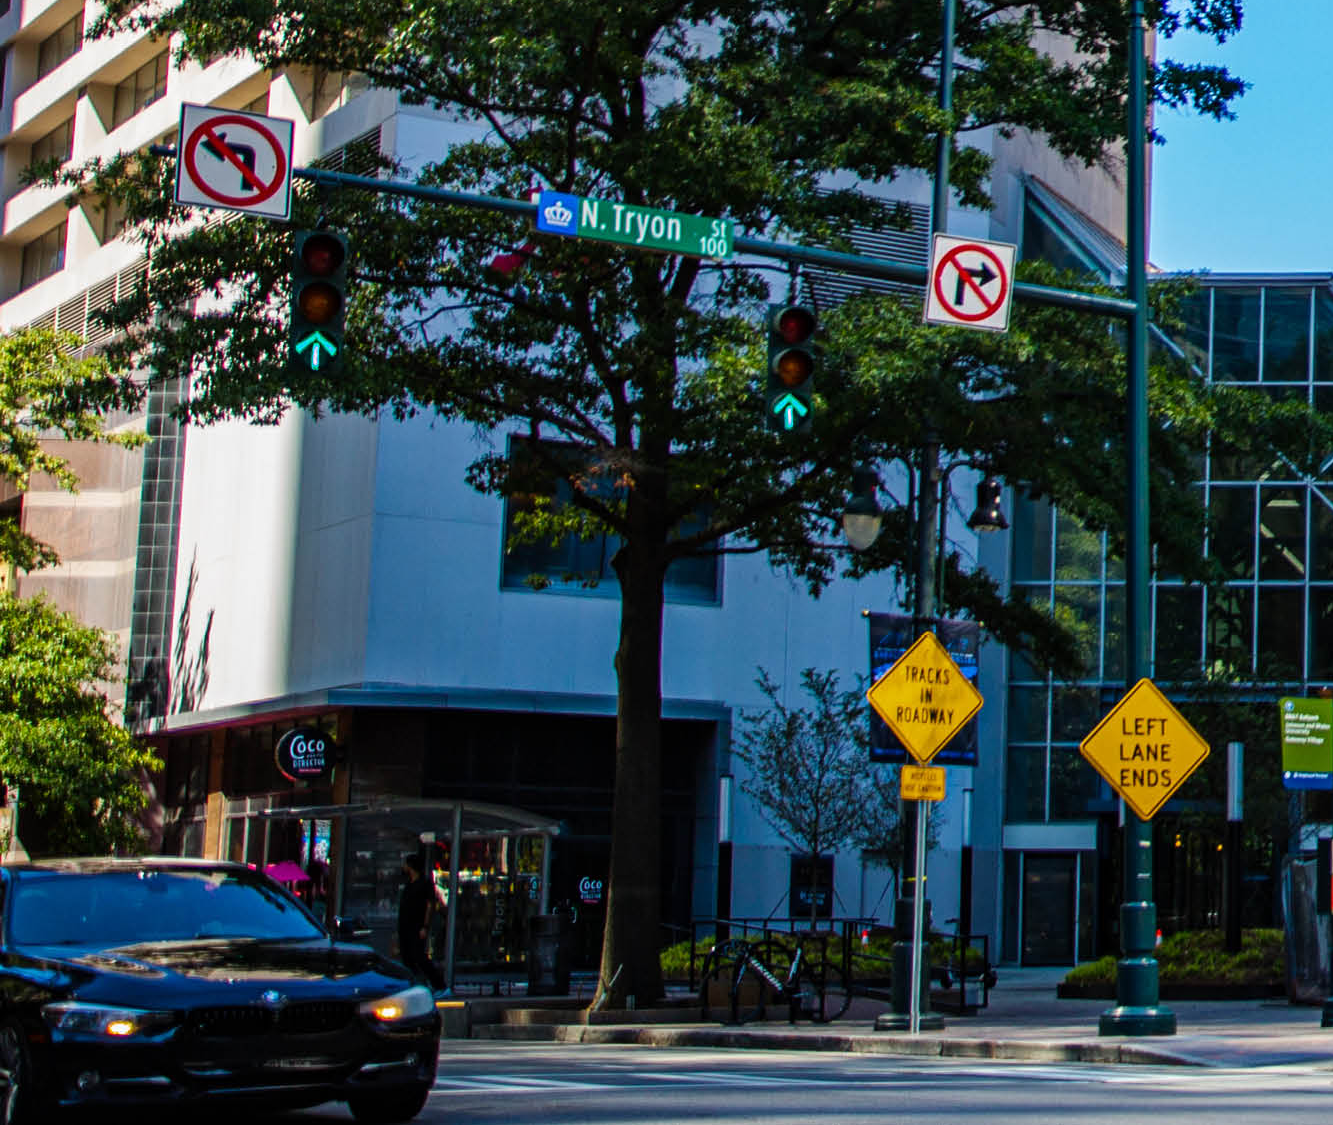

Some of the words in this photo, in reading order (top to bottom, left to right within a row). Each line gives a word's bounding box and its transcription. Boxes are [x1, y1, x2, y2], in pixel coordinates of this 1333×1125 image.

[581, 200, 606, 230] N.
[612, 204, 681, 244] Tryon
[711, 220, 727, 238] St
[700, 236, 728, 256] 100
[905, 665, 950, 685] TRACKS
[920, 687, 933, 703] IN
[896, 706, 954, 725] ROADWAY
[1122, 717, 1168, 736] LEFT
[1120, 743, 1171, 762] LANE
[1120, 768, 1172, 787] ENDS
